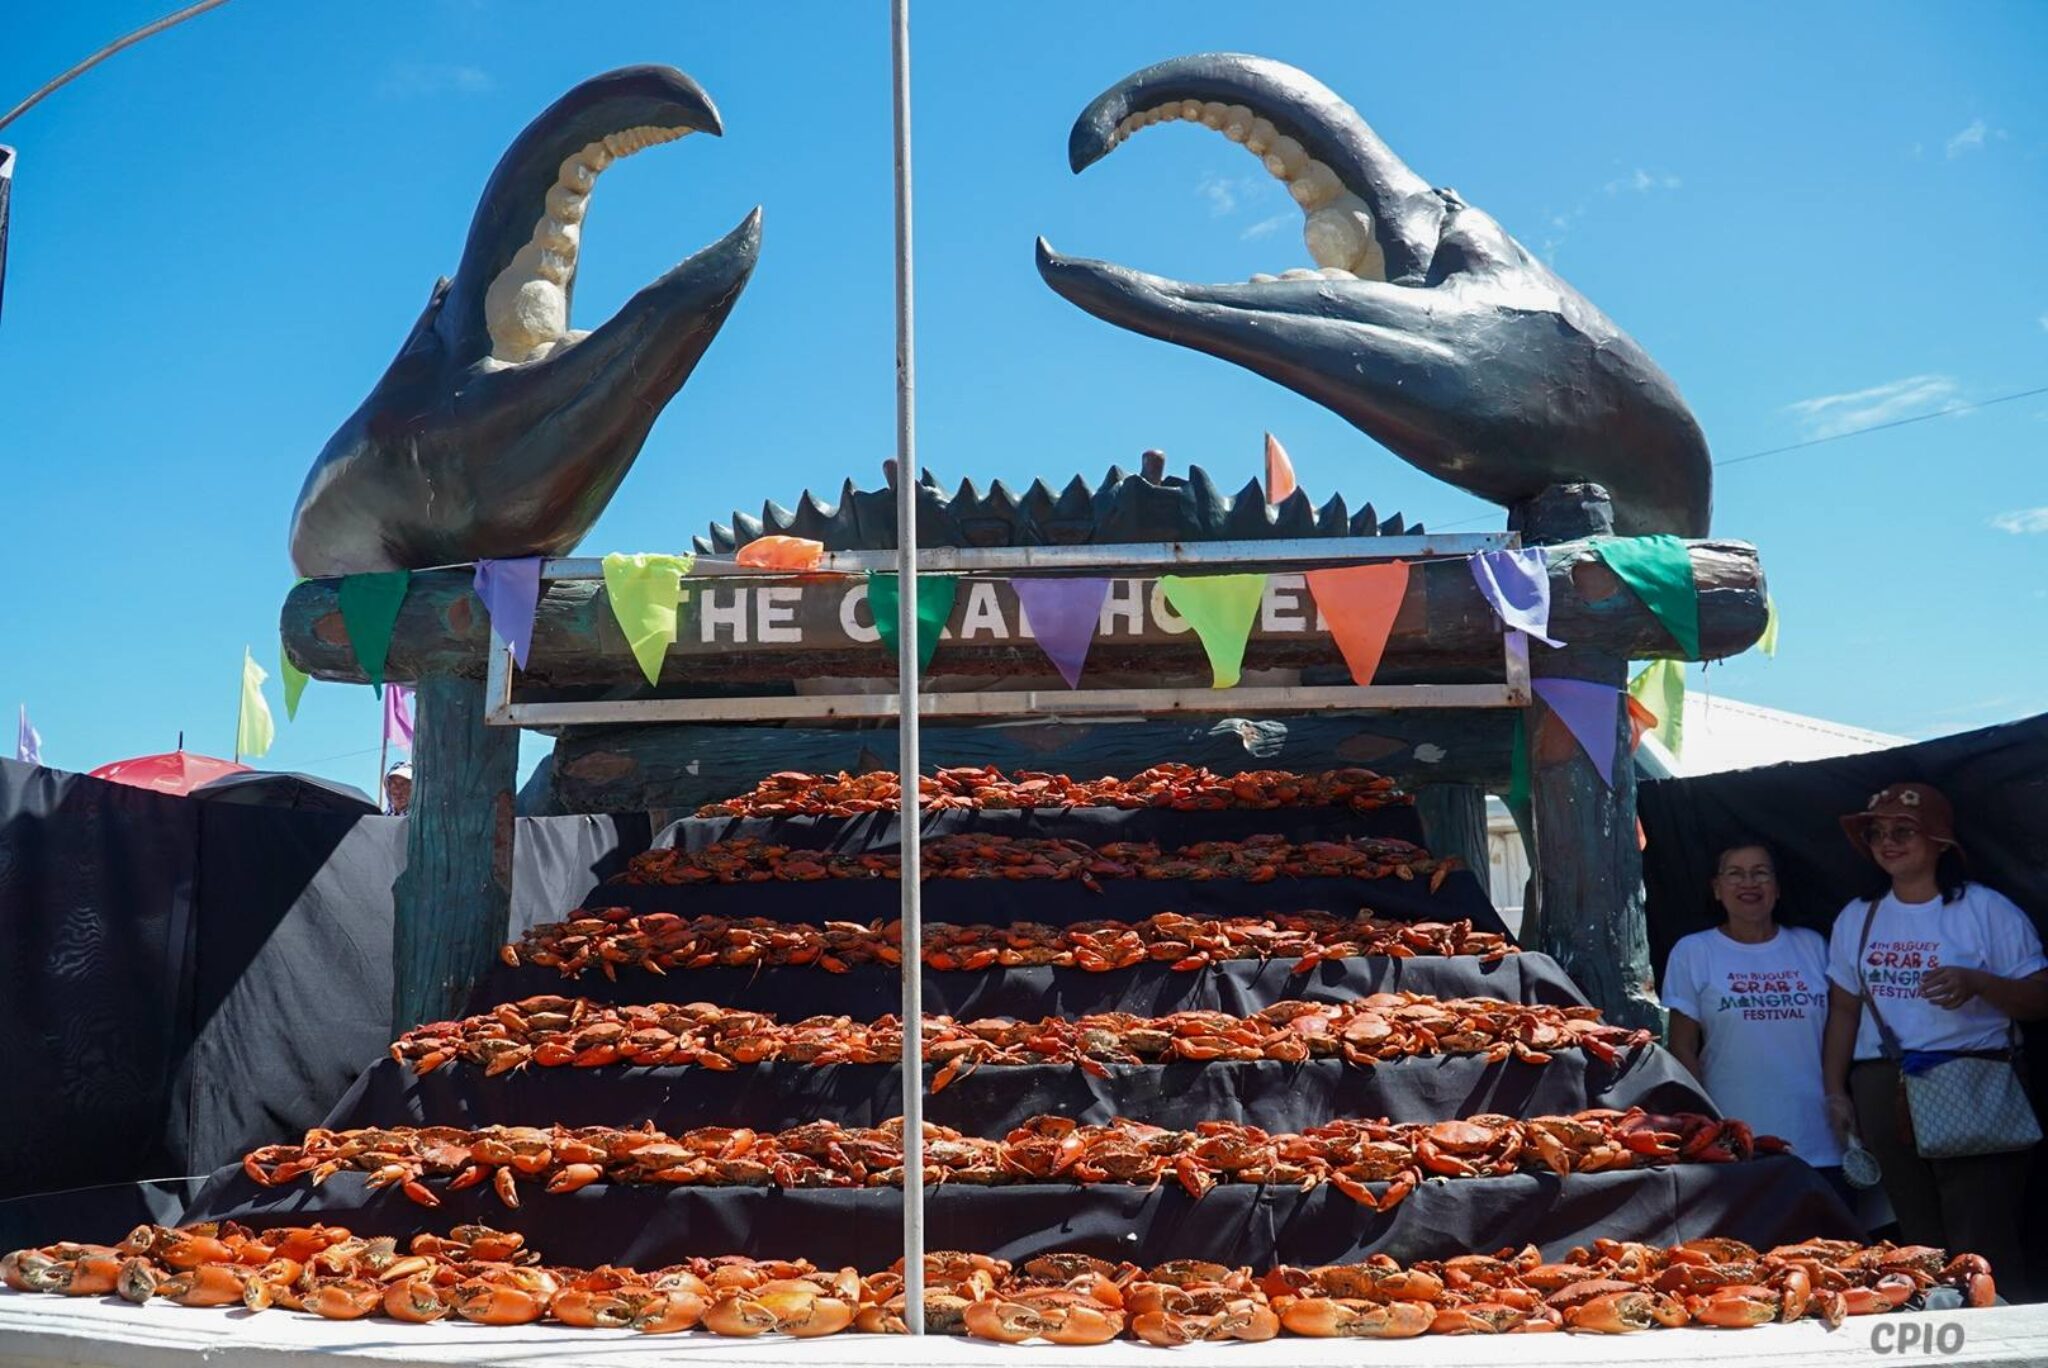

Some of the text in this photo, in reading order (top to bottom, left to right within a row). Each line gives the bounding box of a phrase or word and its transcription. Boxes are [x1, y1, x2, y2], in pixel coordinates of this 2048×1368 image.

[1867, 950, 1940, 969] CRAB &
[1729, 980, 1808, 994] CRAB &
[1743, 1008, 1805, 1021] FESTIVAL
